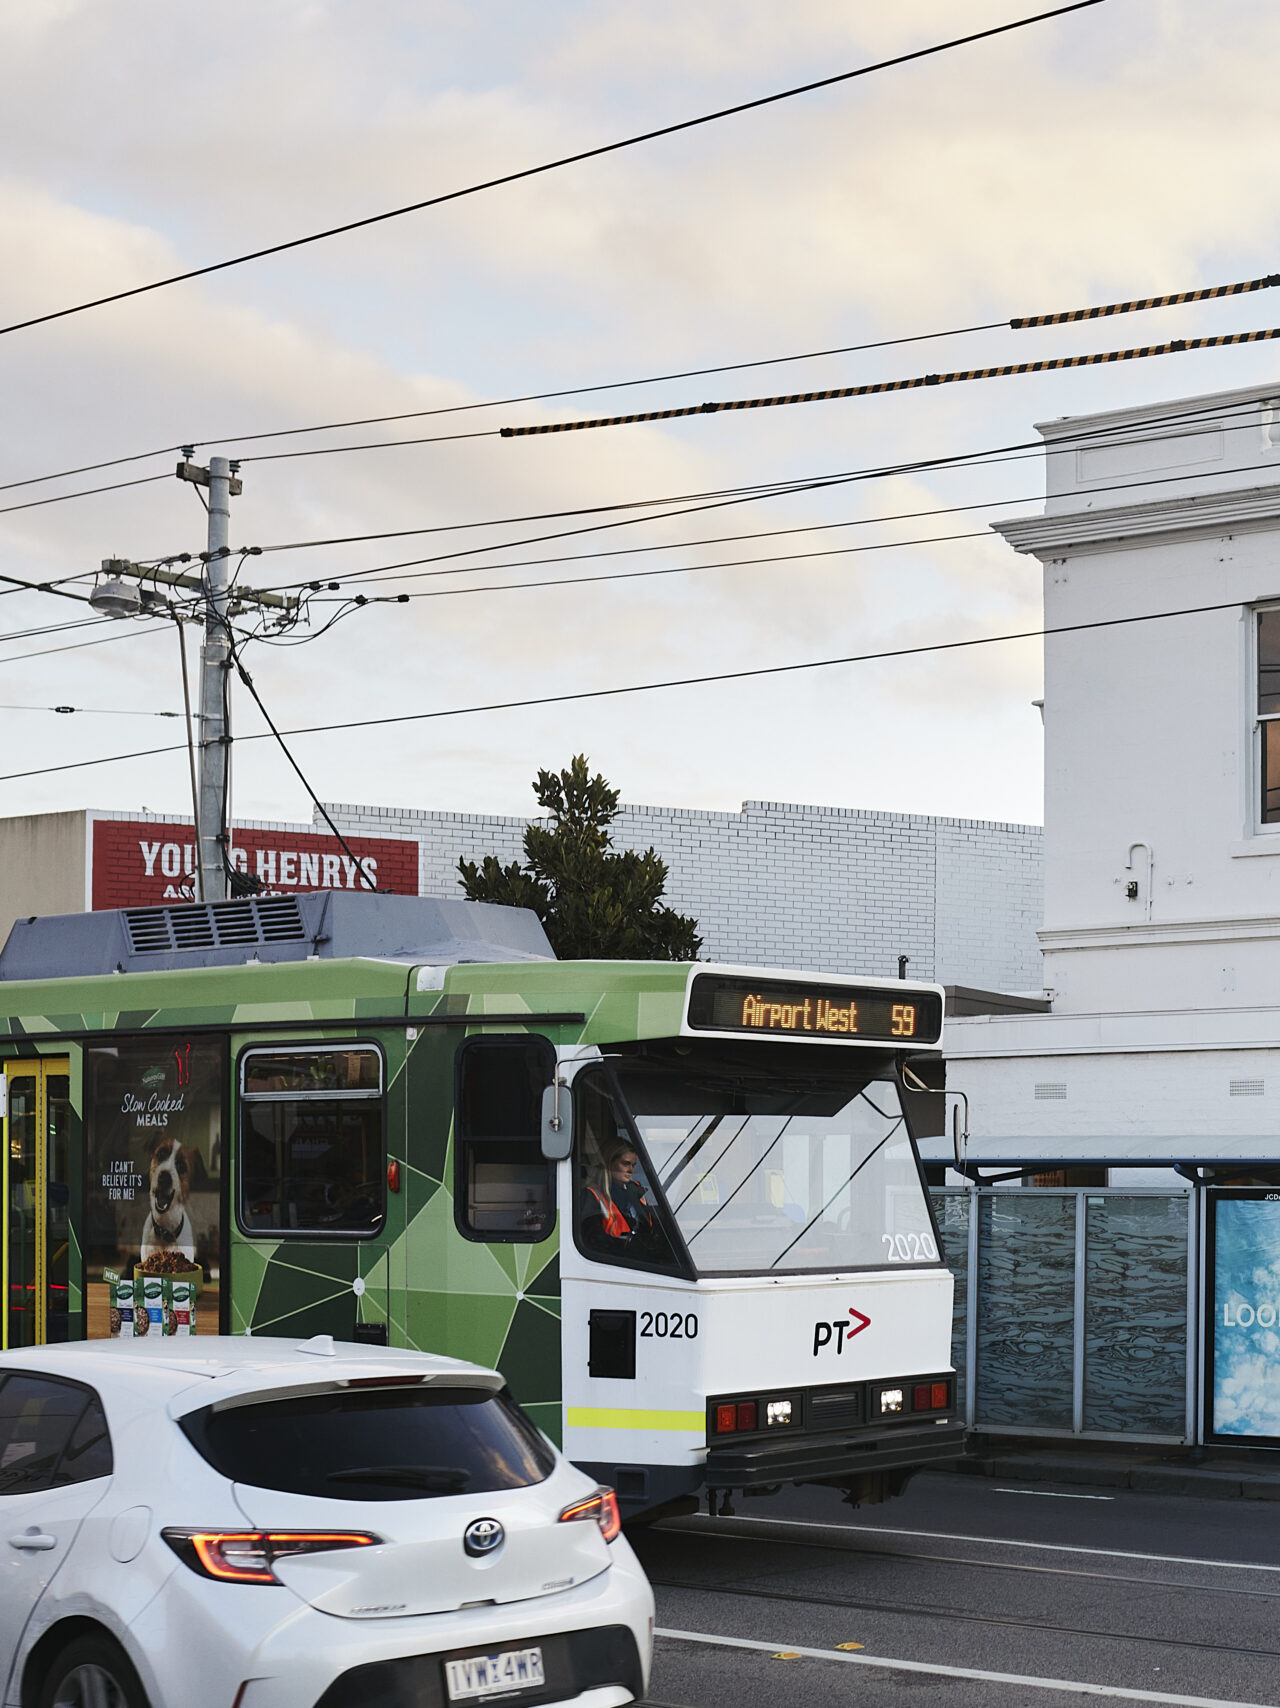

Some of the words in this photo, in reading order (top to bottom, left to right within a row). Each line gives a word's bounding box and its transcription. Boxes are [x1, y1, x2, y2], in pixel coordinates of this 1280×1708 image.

[138, 841, 248, 880] YOUG
[255, 850, 378, 889] HENRYS
[741, 994, 812, 1031] Airport
[815, 998, 859, 1033] West
[890, 1004, 916, 1037] 59
[121, 1092, 146, 1113] Slow
[147, 1092, 185, 1113] Cooked
[136, 1113, 169, 1127] MEALS
[115, 1161, 135, 1173] CAN'T
[102, 1174, 128, 1187] BELIEVE
[129, 1174, 142, 1187] IT'S
[108, 1188, 121, 1200] FOR
[123, 1188, 135, 1200] ME!
[881, 1232, 937, 1262] 2020
[105, 1271, 119, 1283] NEW
[639, 1311, 699, 1339] 2020
